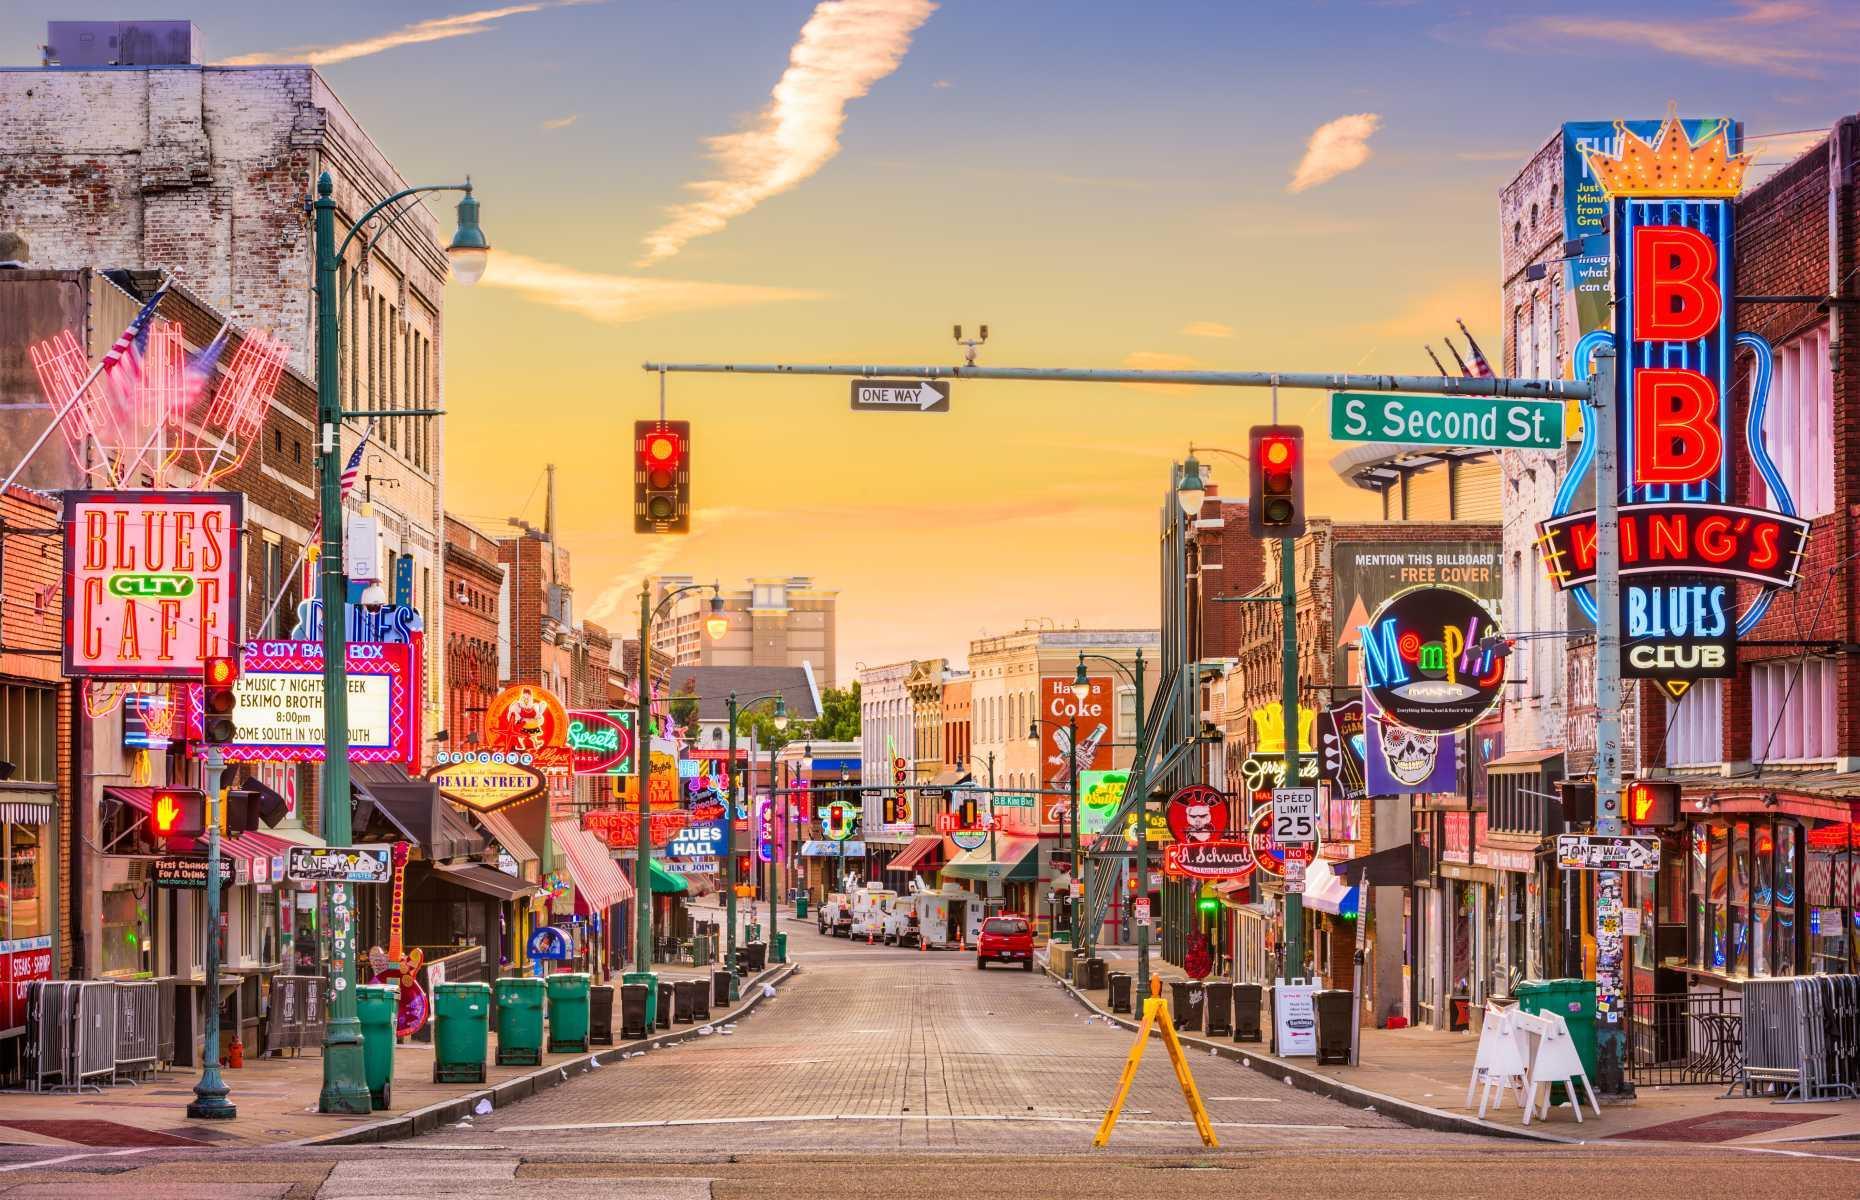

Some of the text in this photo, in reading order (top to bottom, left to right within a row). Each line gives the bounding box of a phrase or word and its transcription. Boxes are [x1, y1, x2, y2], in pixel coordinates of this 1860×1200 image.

[1577, 182, 1600, 192] Just
[1577, 204, 1603, 214] from
[1579, 266, 1609, 277] what
[1579, 283, 1600, 292] can
[862, 389, 922, 403] ONE WAY
[1344, 400, 1551, 444] S. Second St.
[83, 510, 222, 573] BLUES
[1570, 514, 1780, 571] KING'S
[1355, 554, 1403, 566] MENTION
[1407, 554, 1432, 565] THIS
[1436, 554, 1493, 566] BILLBOARD
[1401, 567, 1489, 583] FREE COVER
[116, 577, 188, 593] CITY
[1629, 586, 1726, 637] BLUES
[83, 576, 219, 662] CAFE
[263, 642, 297, 657] CITY
[302, 642, 324, 658] BA
[350, 645, 383, 658] BOX
[1630, 645, 1726, 669] CLUB
[246, 679, 276, 692] MUSIC
[280, 680, 286, 692] 7
[290, 680, 325, 693] NIGHTS
[348, 680, 366, 693] EEK
[1053, 681, 1101, 694] Hav a
[240, 695, 324, 709] ESKIMO BROTH
[1051, 698, 1103, 717] Coke
[276, 711, 311, 723] 8:00pm
[1344, 712, 1363, 721] BLA
[234, 728, 370, 742] SOME SOUTH IN YOU OUTH
[567, 721, 618, 751] Sweets
[436, 751, 533, 765] WELCOME
[437, 776, 532, 788] BEALE STREET
[1242, 759, 1286, 792] Jerry
[1255, 792, 1273, 800] HAL
[1276, 794, 1312, 803] SPEED
[1280, 805, 1307, 814] LIMIT
[632, 814, 685, 828] PLACE
[1278, 817, 1312, 836] 25
[610, 830, 662, 844] CAE
[677, 827, 722, 841] LUES
[673, 843, 715, 855] HALL
[1289, 849, 1302, 858] NO
[156, 860, 177, 869] First
[666, 863, 715, 872] JUKE JOINT
[159, 870, 172, 878] For
